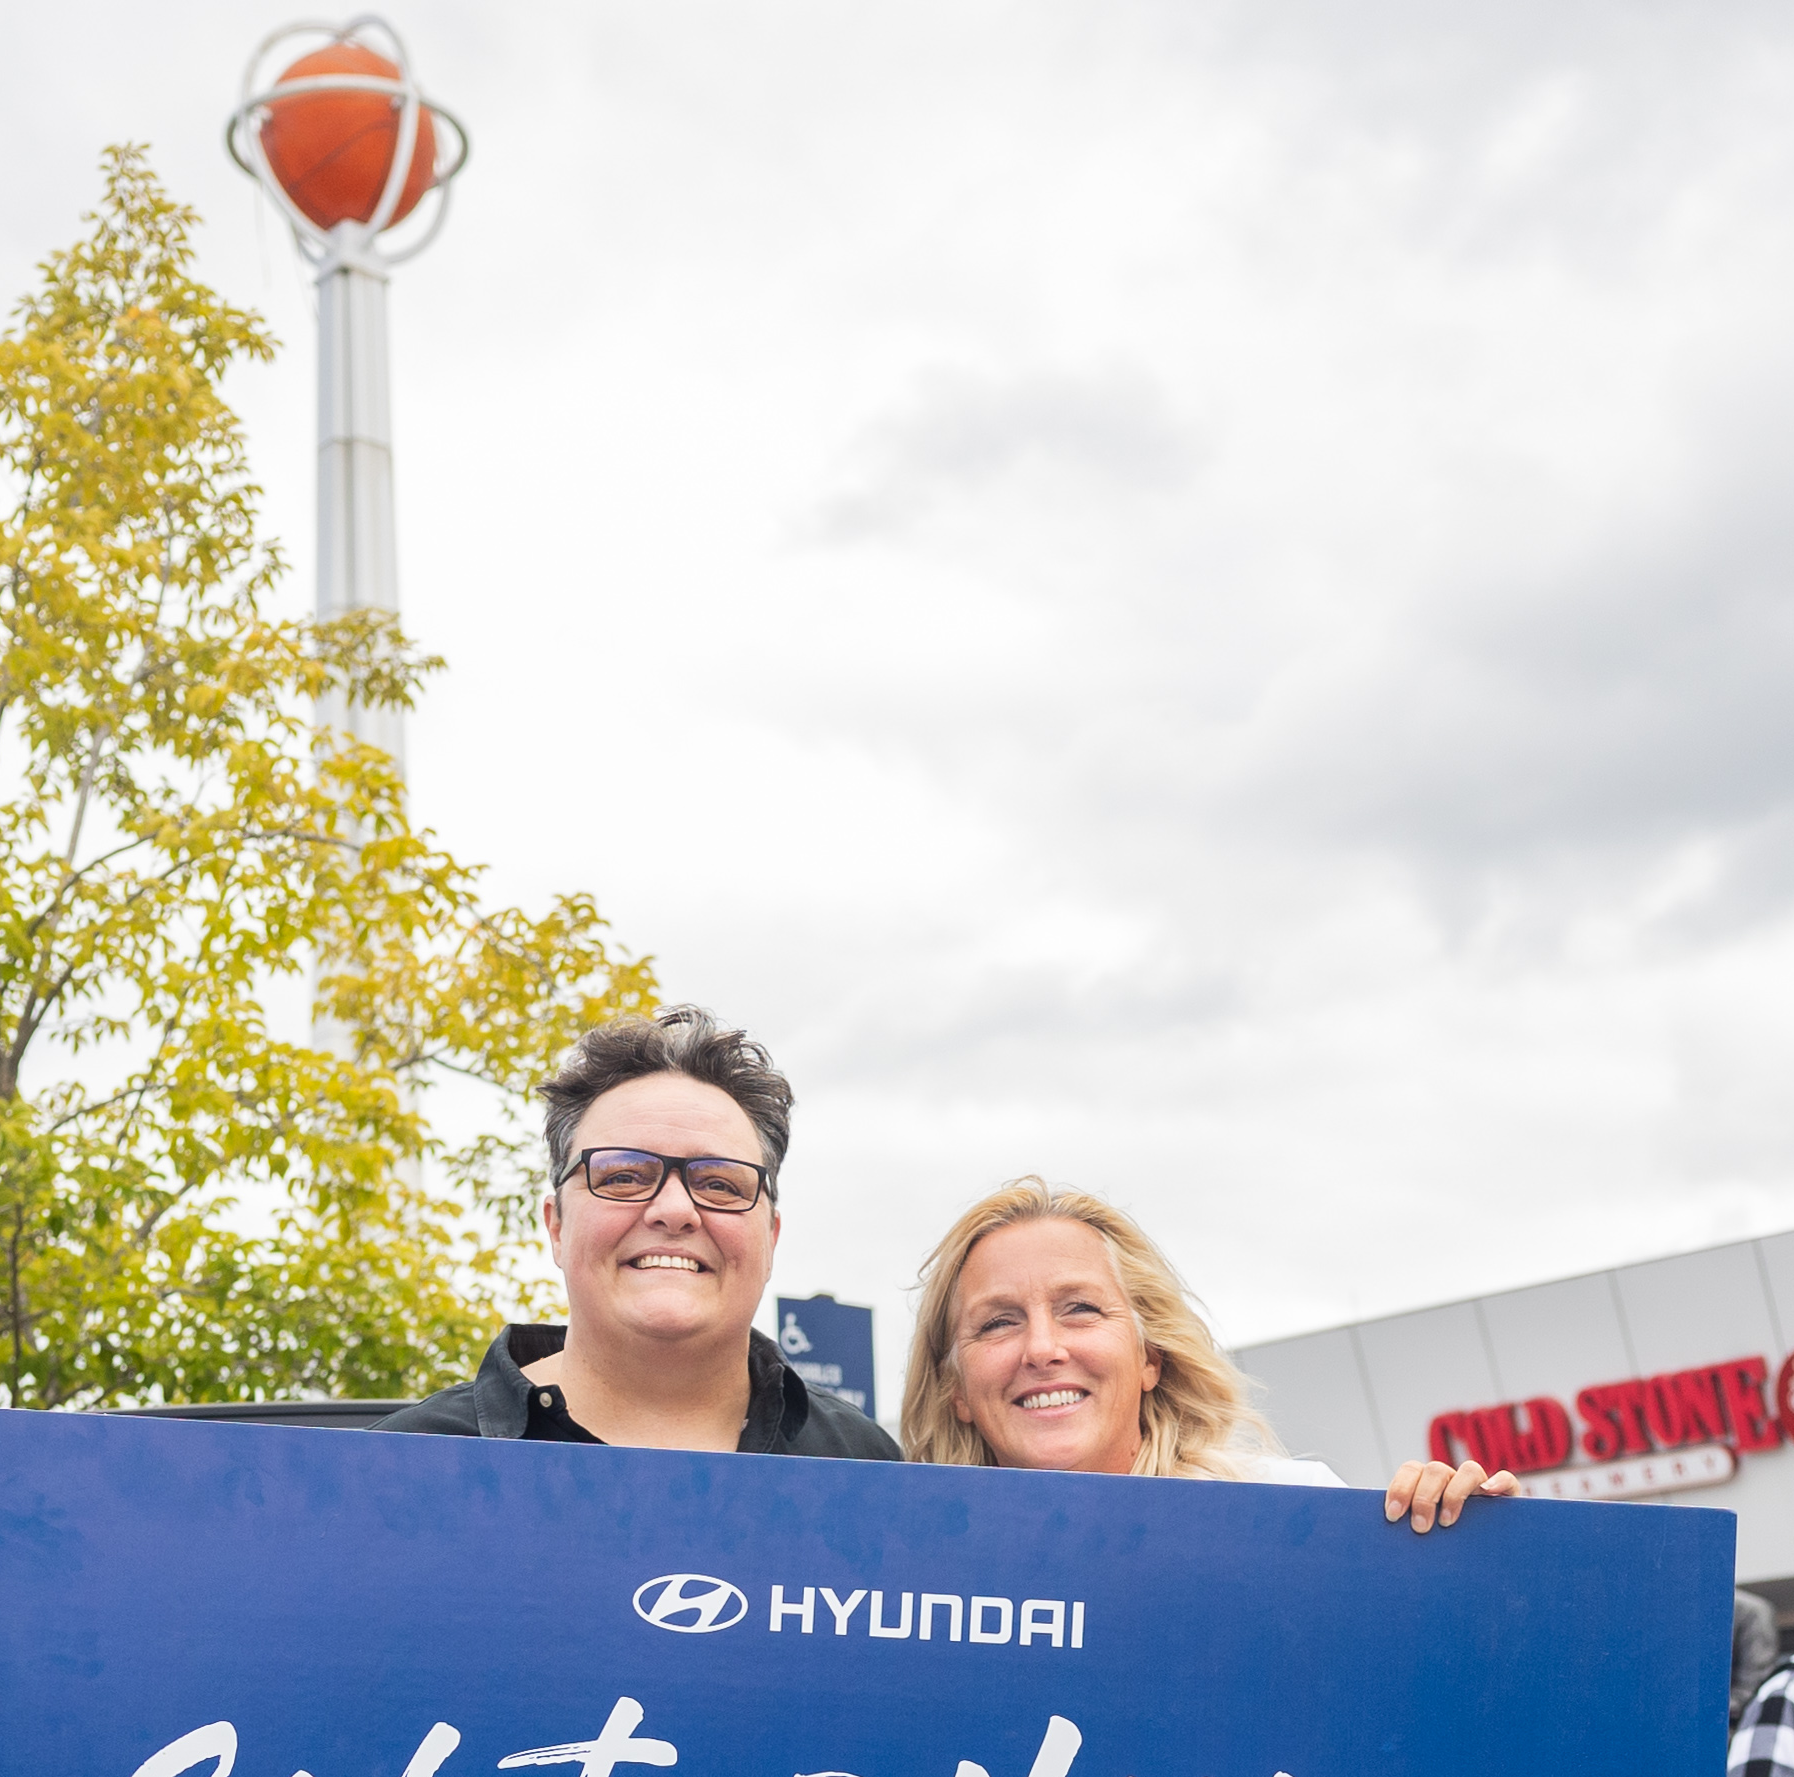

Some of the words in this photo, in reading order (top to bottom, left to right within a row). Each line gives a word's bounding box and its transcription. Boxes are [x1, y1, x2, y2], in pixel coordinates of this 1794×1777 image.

[1428, 1397, 1572, 1477] COLD
[1576, 1354, 1784, 1463] STONE
[769, 1584, 1085, 1649] HYUNDAI
